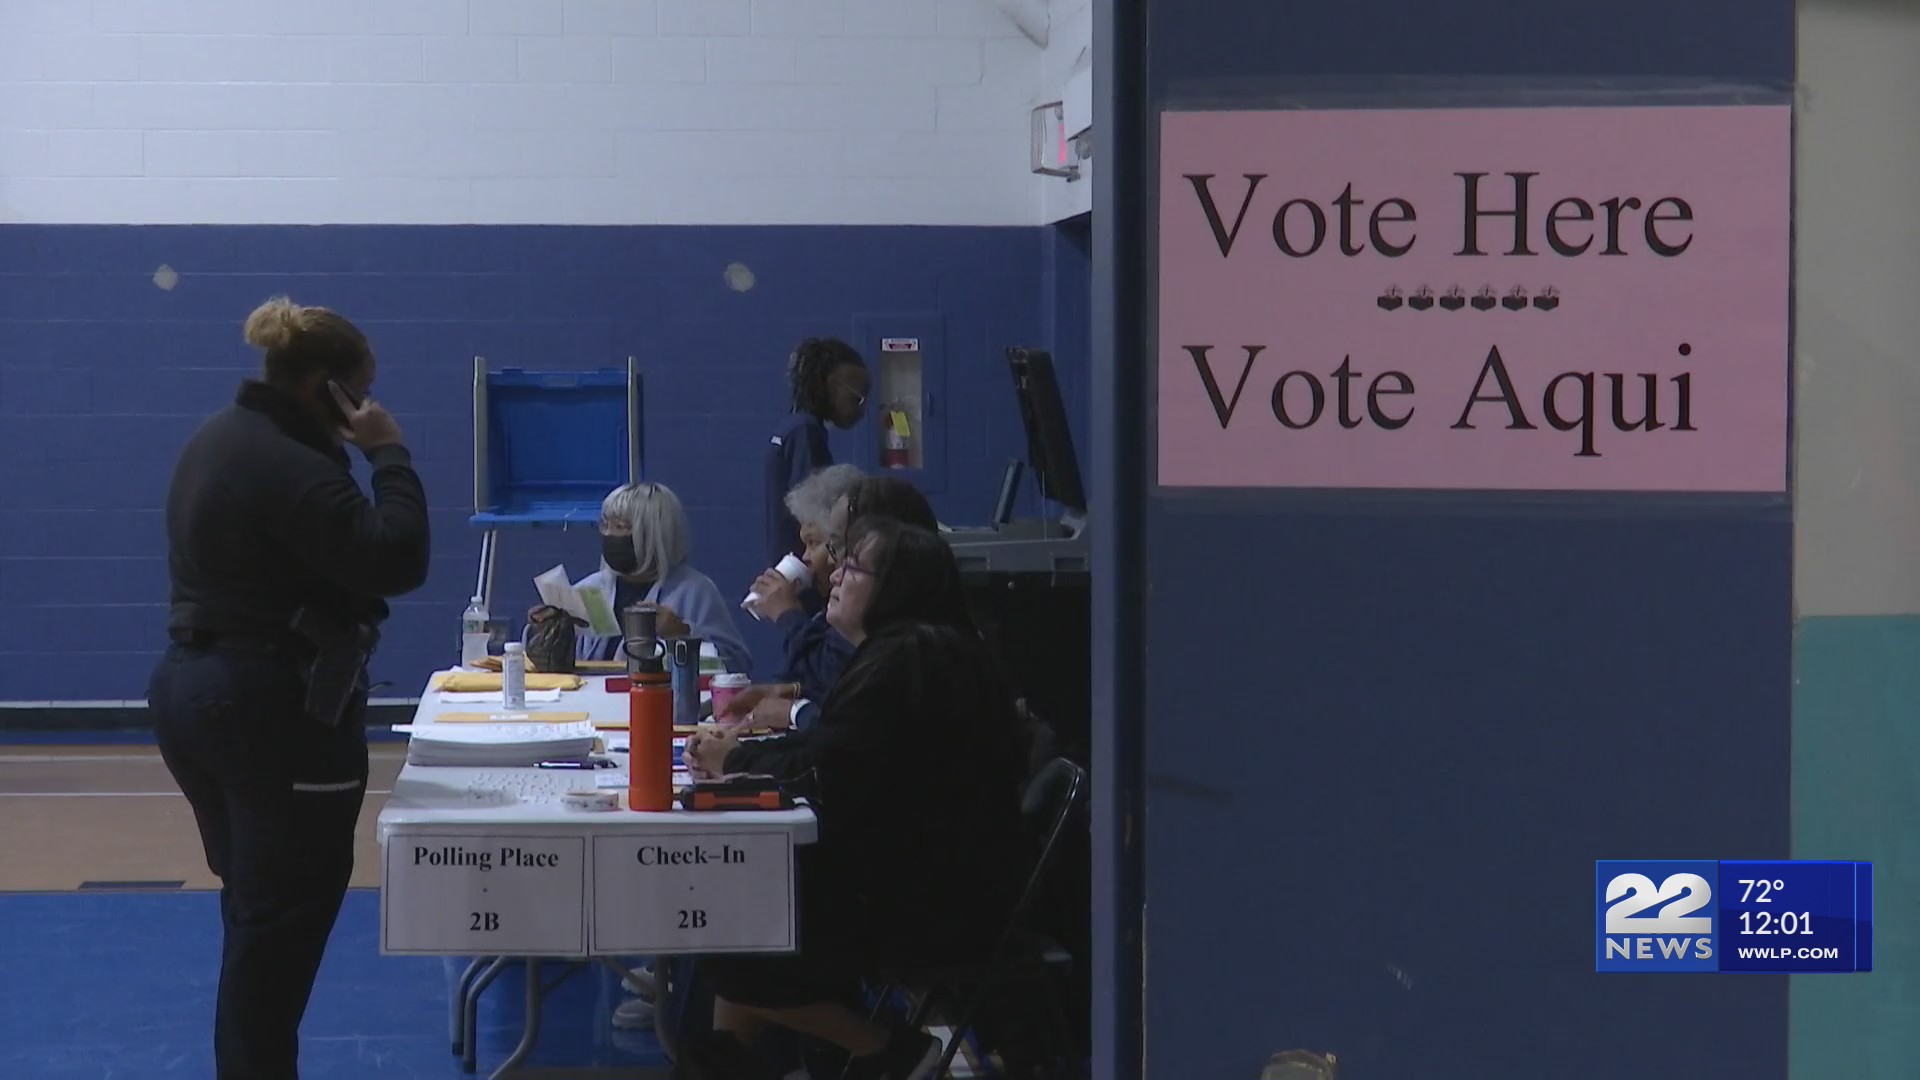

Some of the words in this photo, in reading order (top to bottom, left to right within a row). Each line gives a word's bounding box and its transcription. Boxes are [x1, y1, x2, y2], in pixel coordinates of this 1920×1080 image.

[1182, 174, 1417, 259] Vote
[1453, 172, 1694, 258] Here
[1181, 345, 1415, 430] Vote
[1449, 343, 1698, 457] Aqui
[413, 847, 492, 871] Polling
[500, 848, 559, 868] Place
[470, 912, 499, 931] 2B
[678, 909, 708, 930] 2B
